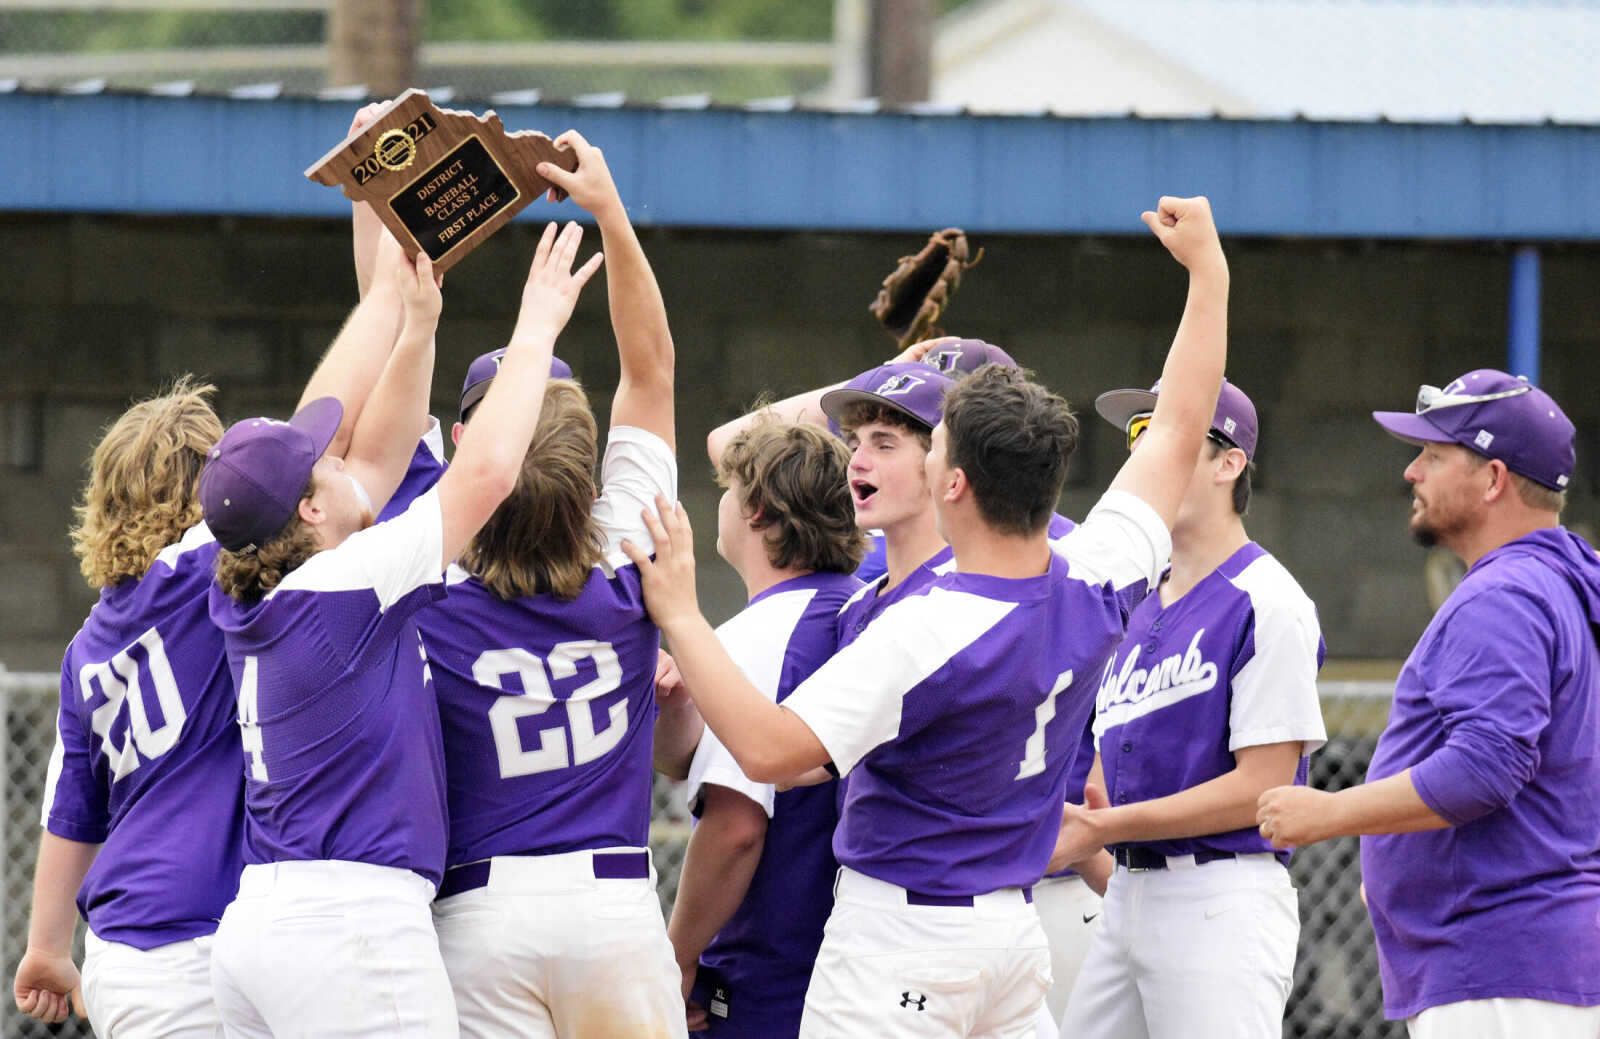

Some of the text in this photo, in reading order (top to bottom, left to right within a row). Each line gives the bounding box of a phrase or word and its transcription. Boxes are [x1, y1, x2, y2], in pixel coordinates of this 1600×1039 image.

[354, 116, 433, 184] 20 21
[416, 160, 464, 201] DISTRICT
[423, 173, 479, 217] BASEBALL
[437, 185, 480, 221] CLASS 2
[438, 192, 499, 243] FIRST PLACE
[79, 626, 188, 784] 20
[236, 656, 270, 782] 4
[471, 639, 630, 779] 22
[1014, 668, 1074, 781] 1
